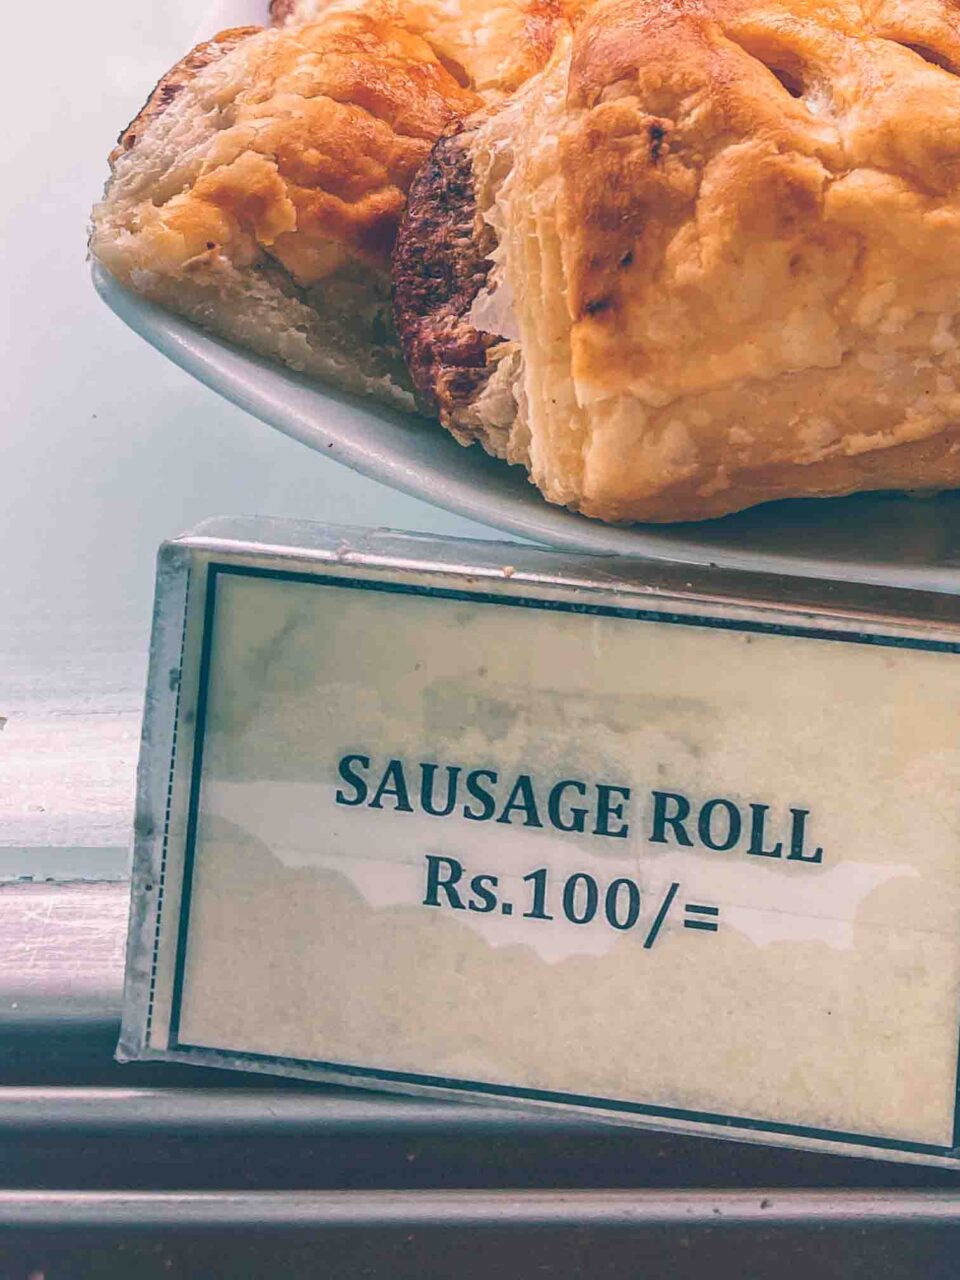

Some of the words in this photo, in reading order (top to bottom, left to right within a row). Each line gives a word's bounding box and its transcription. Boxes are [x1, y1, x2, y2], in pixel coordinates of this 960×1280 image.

[336, 754, 630, 838] SAUSAGE
[649, 791, 823, 864] ROLL
[422, 855, 719, 949] Rs.100/=
